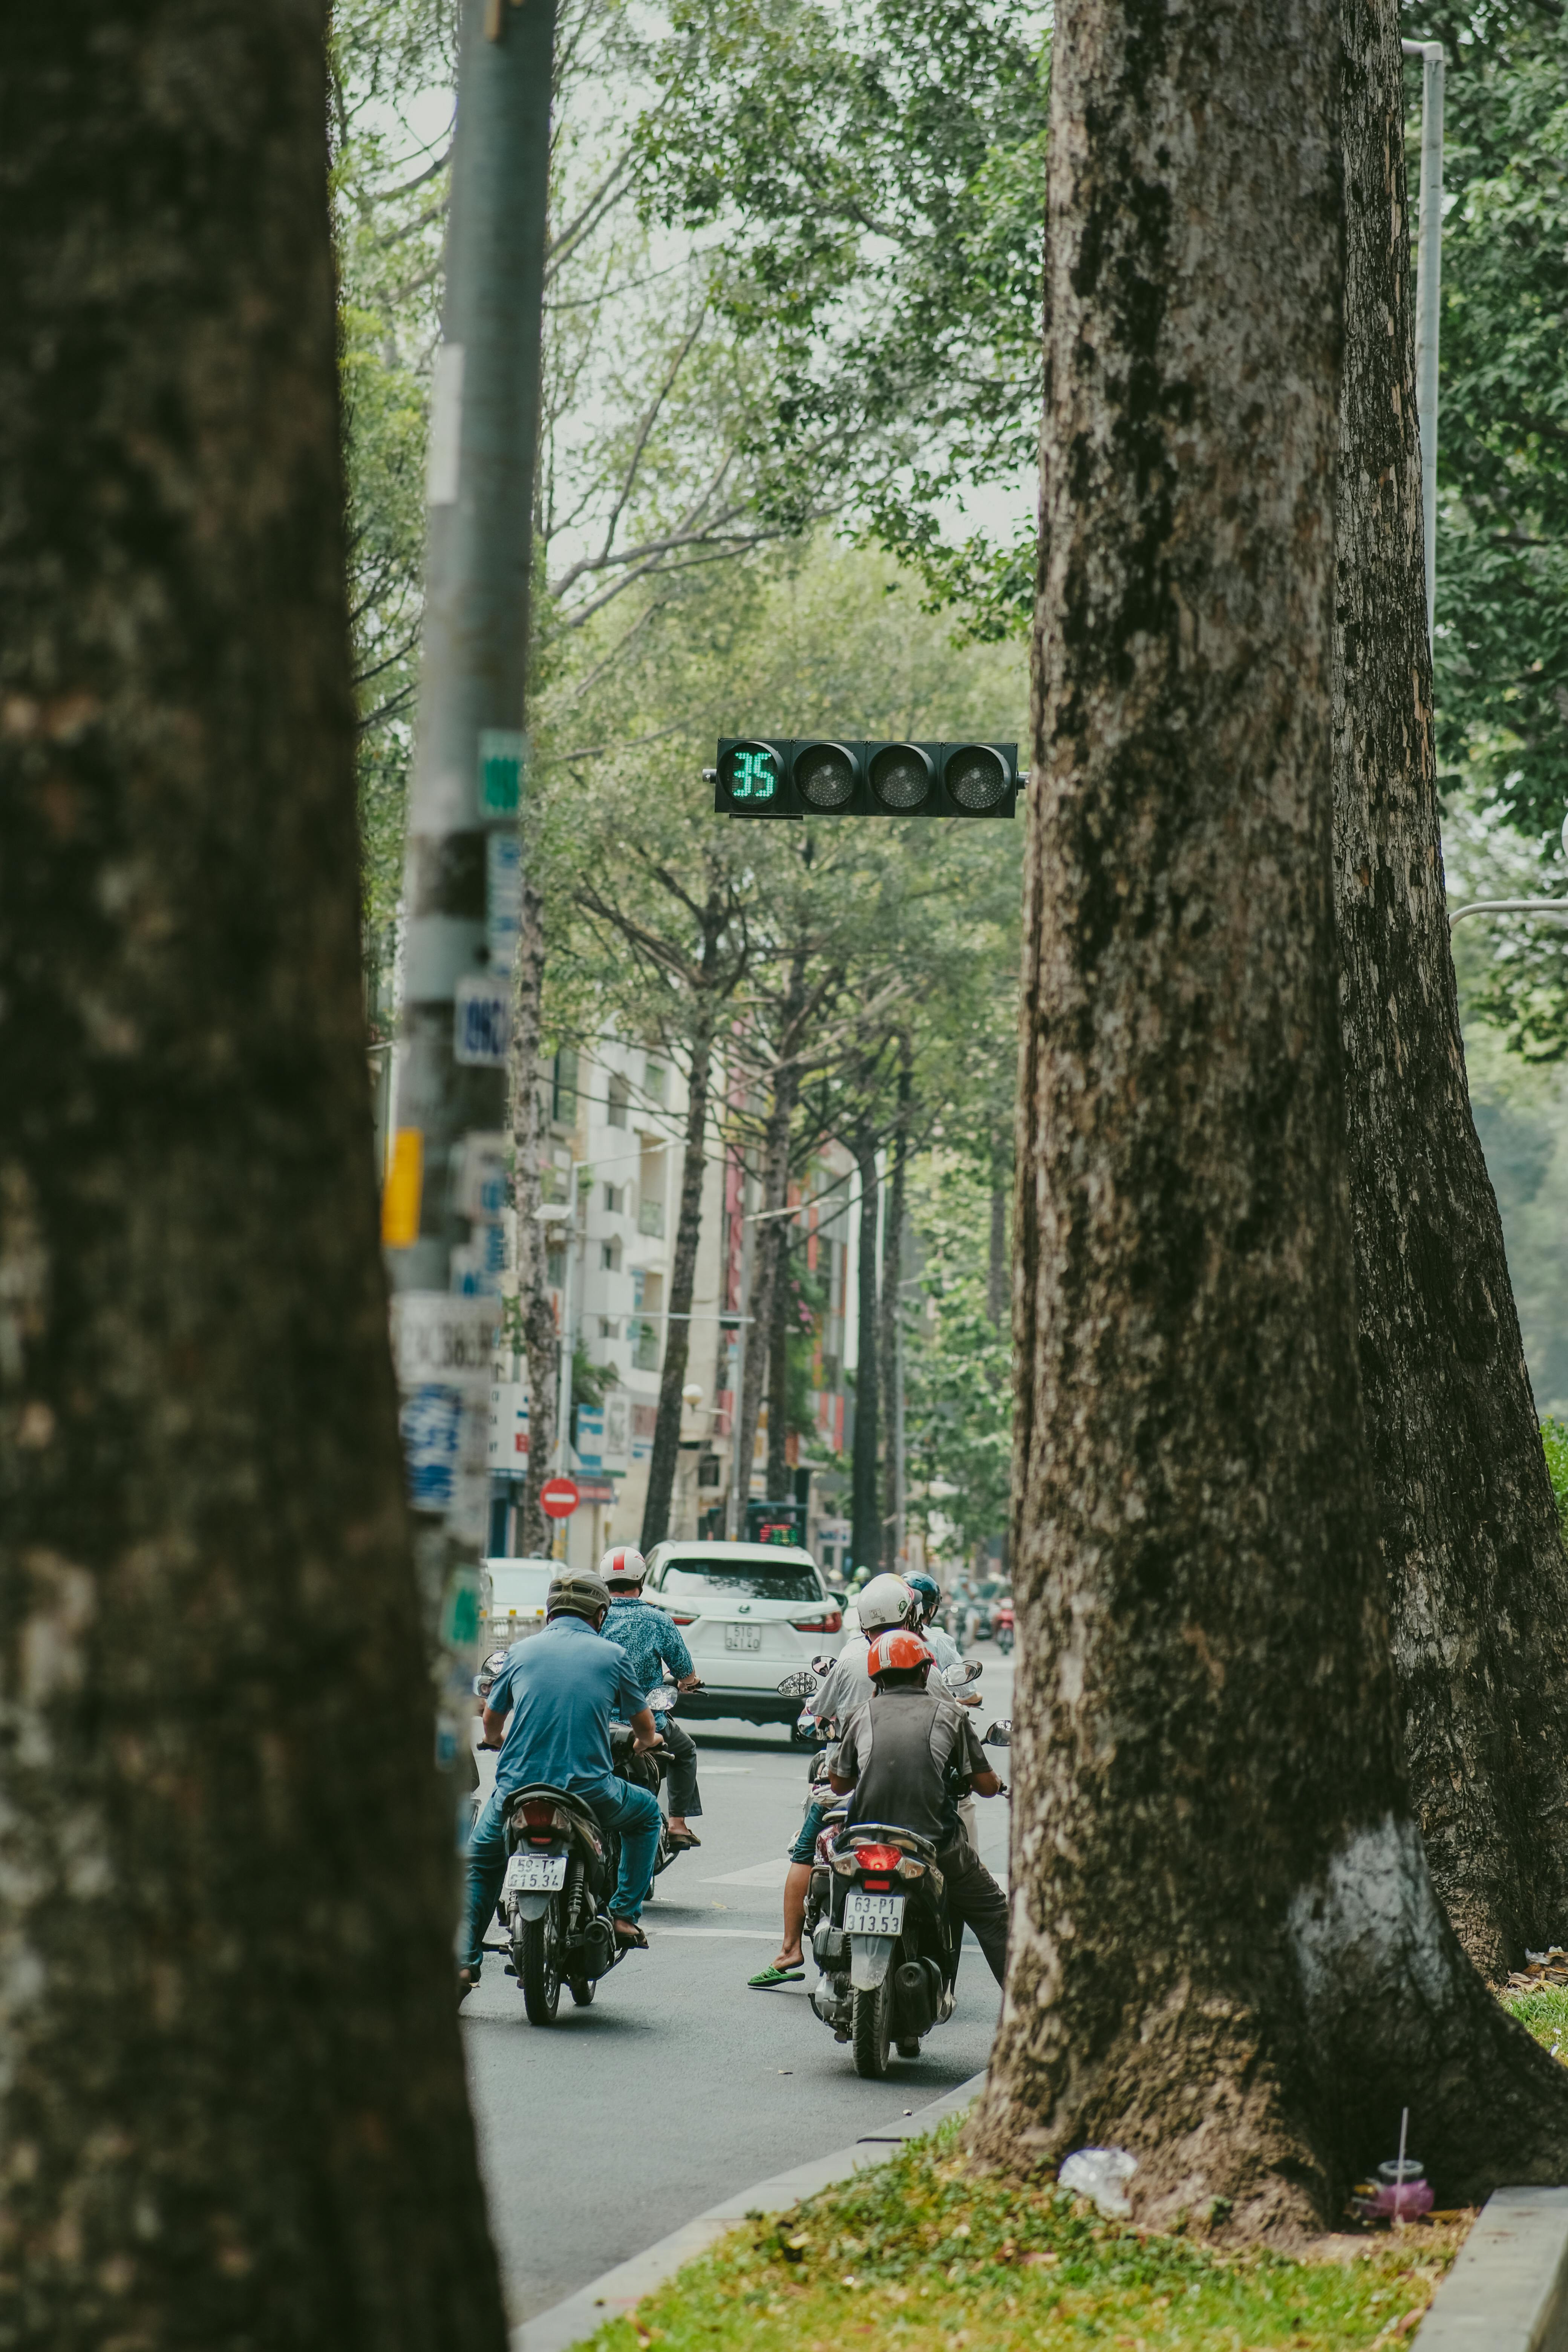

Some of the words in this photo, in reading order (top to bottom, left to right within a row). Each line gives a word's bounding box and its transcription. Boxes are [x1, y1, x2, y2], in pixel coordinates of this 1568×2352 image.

[733, 753, 773, 796] 35
[735, 1626, 752, 1637] 51G
[518, 1859, 554, 1873] 59-T1
[855, 1897, 894, 1914] 63-P1
[848, 1915, 899, 1932] 313.53
